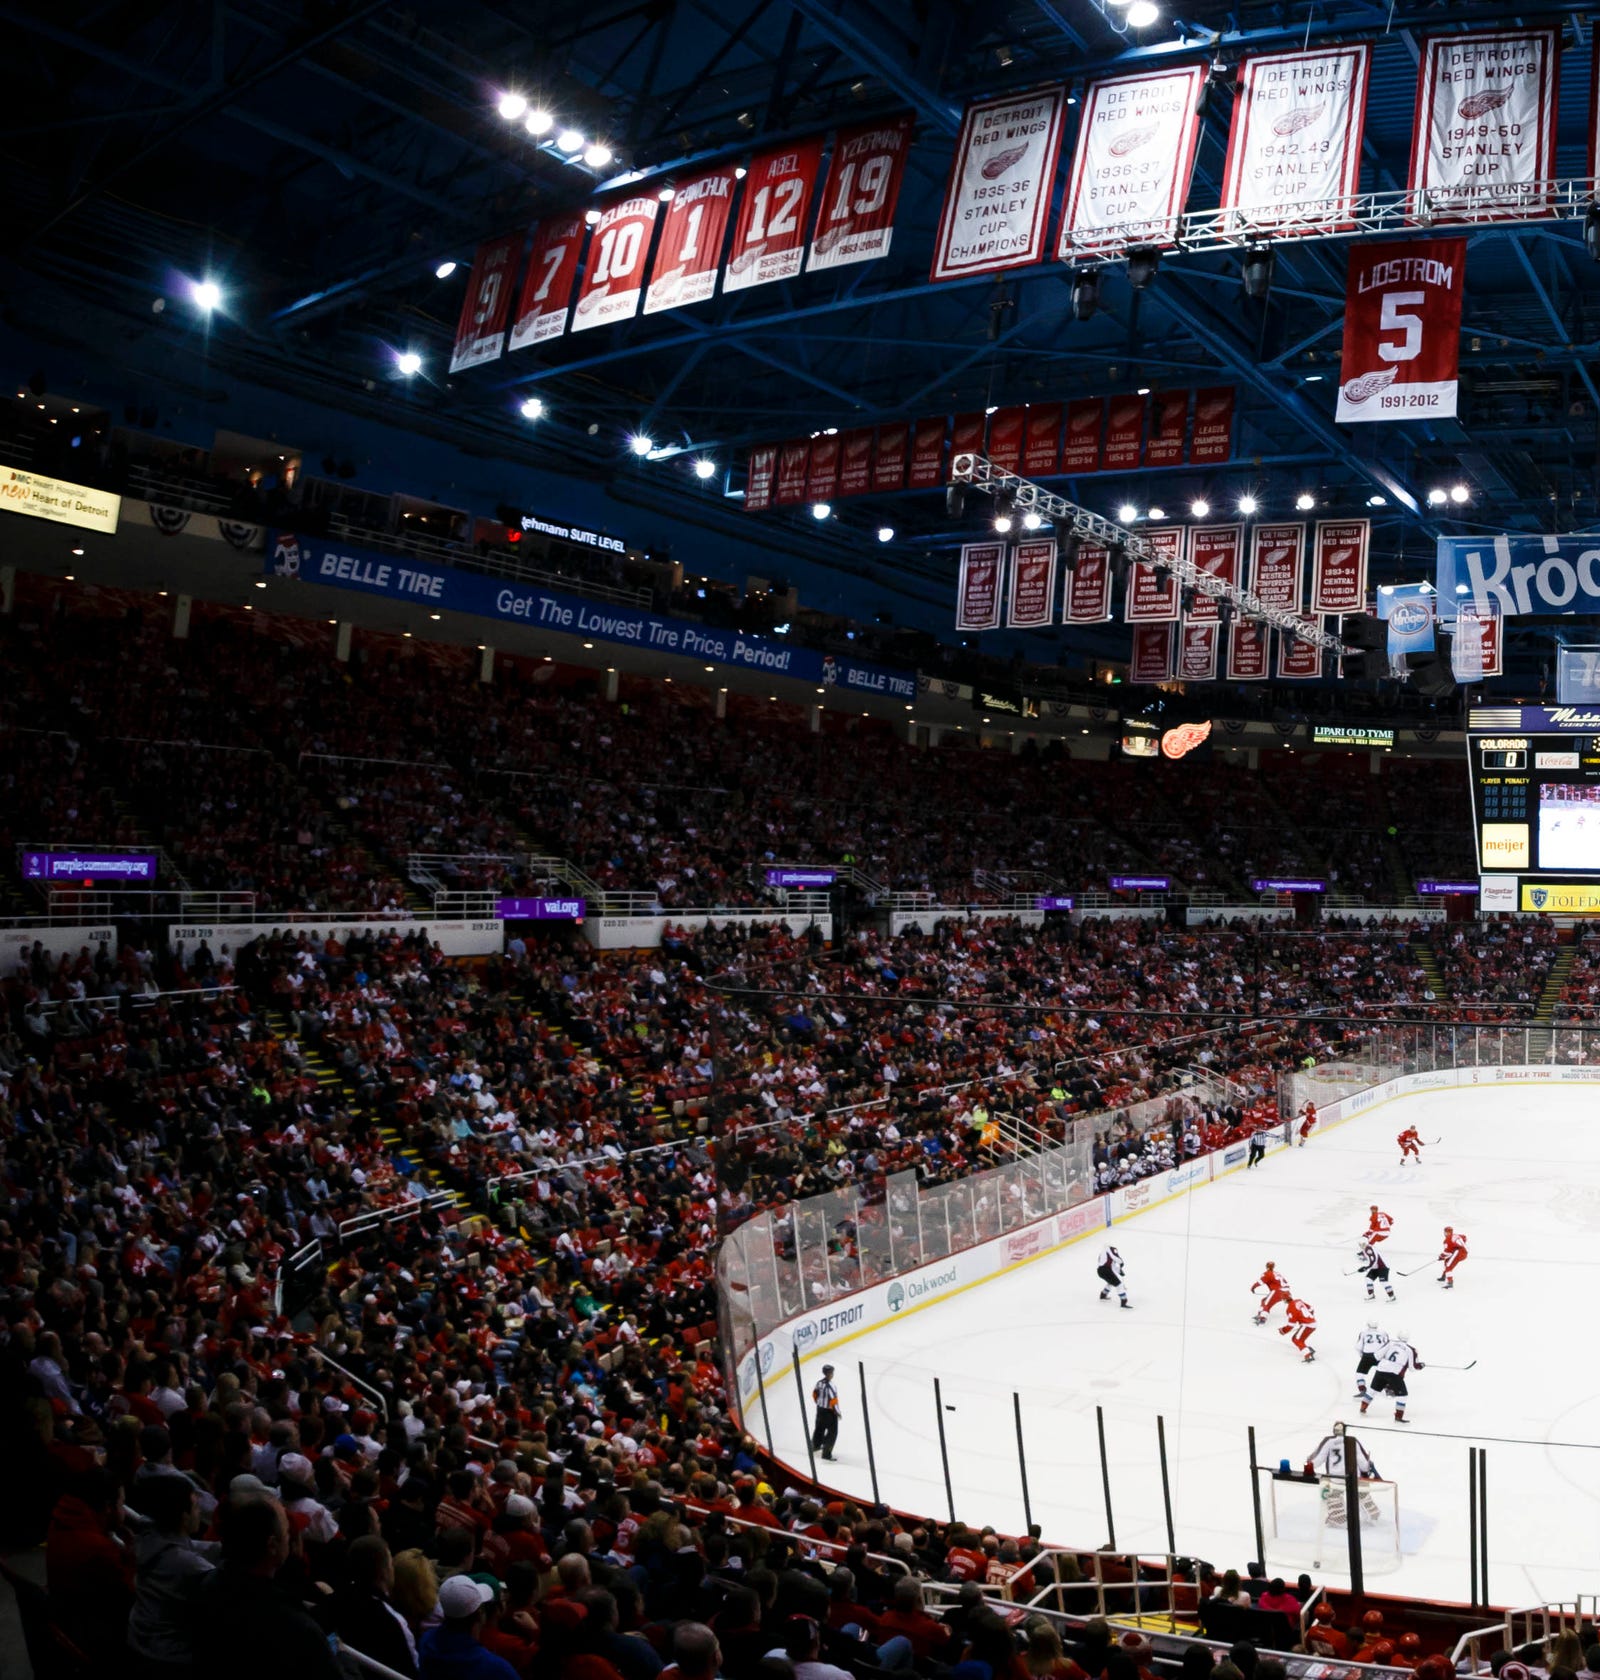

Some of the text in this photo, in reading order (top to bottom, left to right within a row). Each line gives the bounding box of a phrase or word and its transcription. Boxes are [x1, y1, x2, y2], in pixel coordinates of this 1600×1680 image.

[1451, 47, 1528, 65] DETROIT
[1442, 62, 1537, 83] RED WINGS
[983, 105, 1045, 129] DETROIT
[973, 121, 1047, 147] RED WINGS
[1447, 124, 1522, 140] 1949-50
[1442, 142, 1523, 159] STANLEY
[767, 154, 799, 179] ABEL
[1463, 163, 1499, 175] CUP
[673, 176, 732, 212] SAWCHUK
[830, 154, 893, 221] 19
[974, 180, 1030, 199] 1935-36
[746, 178, 804, 243] 12
[964, 199, 1027, 220] STANLEY
[679, 204, 704, 262] 1
[979, 221, 1008, 236] CUP
[592, 221, 644, 284] 10
[951, 234, 1028, 259] CHAMPIONS
[533, 245, 567, 302] 7
[1358, 258, 1453, 294] LIDSTROM
[474, 272, 502, 324] 9
[1378, 291, 1425, 362] 5
[1381, 394, 1439, 408] 1991-2012
[0, 484, 30, 499] new
[33, 491, 58, 506] Heart
[61, 500, 71, 509] of
[75, 501, 108, 517] Detroit
[570, 528, 626, 553] SUITE LEVEL
[320, 553, 445, 598] BELLE TIRE
[496, 589, 791, 670] Get The Lowest Tire Price, Period!
[847, 668, 915, 696] BELLE TIRE
[1315, 727, 1393, 738] LIPARI OLD TYME
[1480, 740, 1527, 749] COLORADO
[1505, 752, 1517, 767] 0
[1485, 839, 1525, 852] meijer
[1484, 887, 1514, 896] Flagstar
[545, 901, 579, 917] vai.org
[1124, 1184, 1149, 1201] Flagstar
[1059, 1214, 1085, 1235] CHER
[1008, 1229, 1040, 1249] Flagstar
[908, 1266, 957, 1298] Oakwood
[797, 1304, 864, 1341] FOX DETROIT
[1366, 1334, 1383, 1344] 25
[1389, 1351, 1399, 1363] 6
[1332, 1448, 1342, 1465] 3
